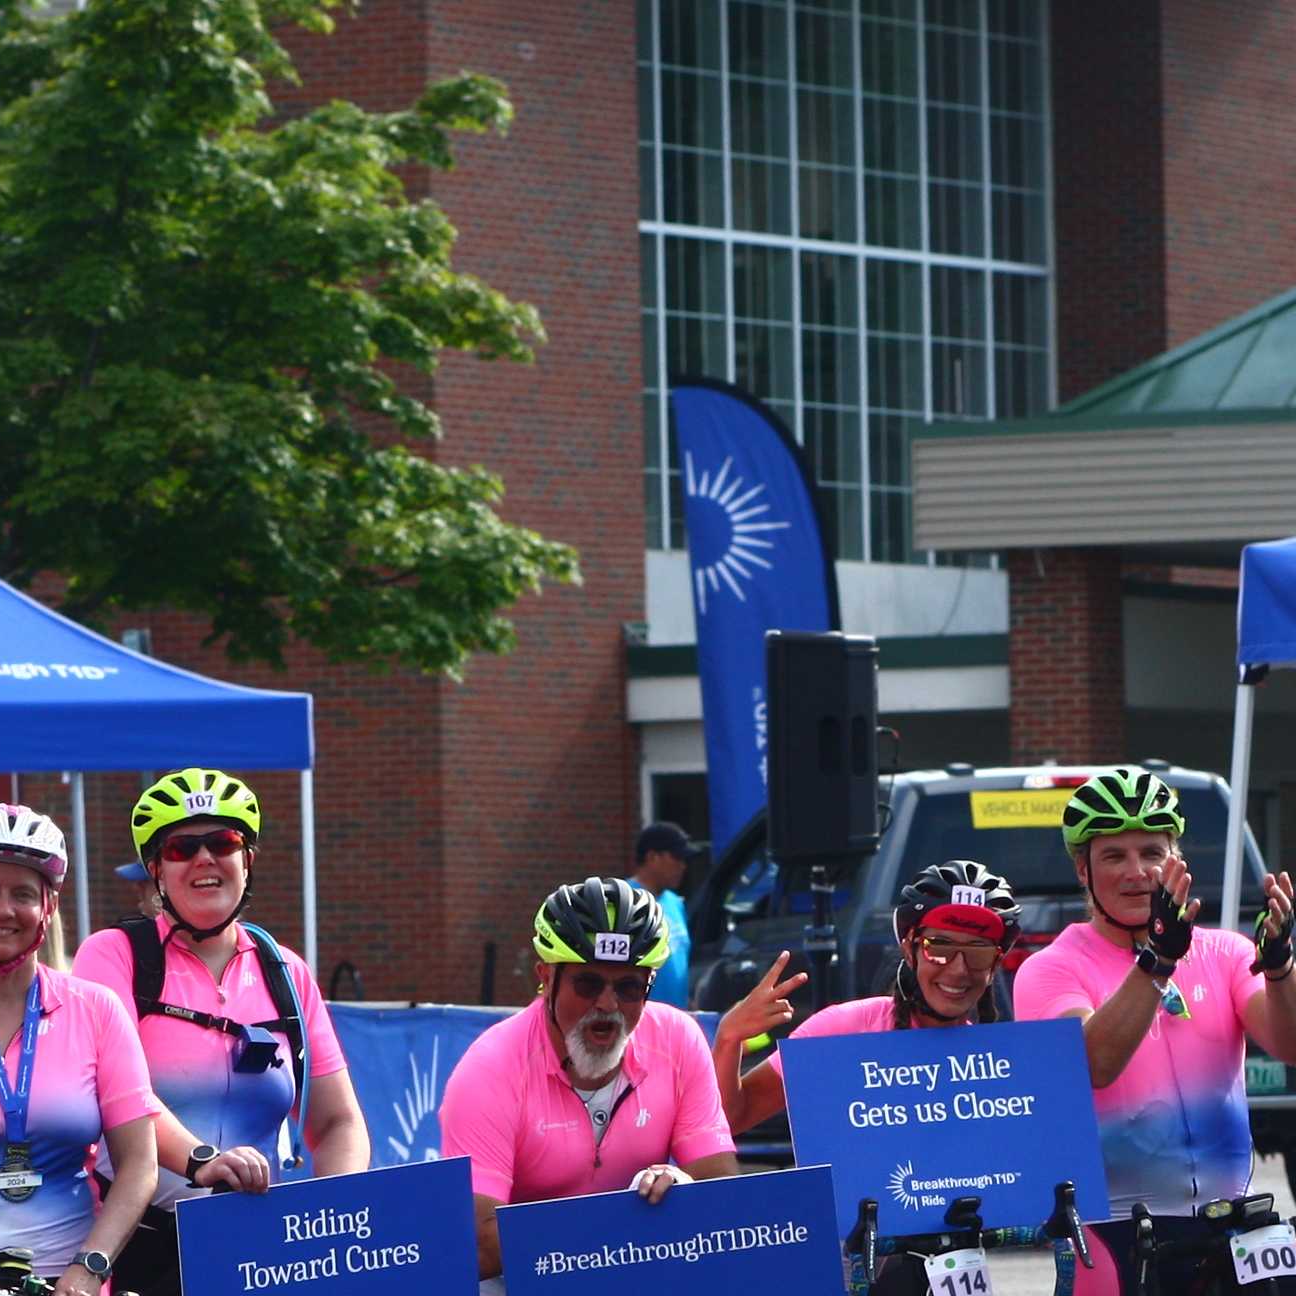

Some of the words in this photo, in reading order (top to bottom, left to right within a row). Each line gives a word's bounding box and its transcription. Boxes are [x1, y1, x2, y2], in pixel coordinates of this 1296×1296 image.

[186, 794, 214, 809] 107
[956, 891, 983, 906] 114
[599, 939, 628, 955] 112
[861, 1062, 940, 1091] Every
[947, 1052, 1010, 1081] Mile
[849, 1102, 907, 1127] Gets
[915, 1103, 946, 1122] us
[954, 1092, 1034, 1119] Closer
[911, 1175, 992, 1190] Breakthrough
[921, 1195, 945, 1206] Ride
[283, 1207, 371, 1242] Riding
[535, 1222, 807, 1275] #BreakthroughT1DRide
[1242, 1246, 1296, 1275] 100
[239, 1248, 338, 1290] Toward
[346, 1244, 419, 1272] Cures
